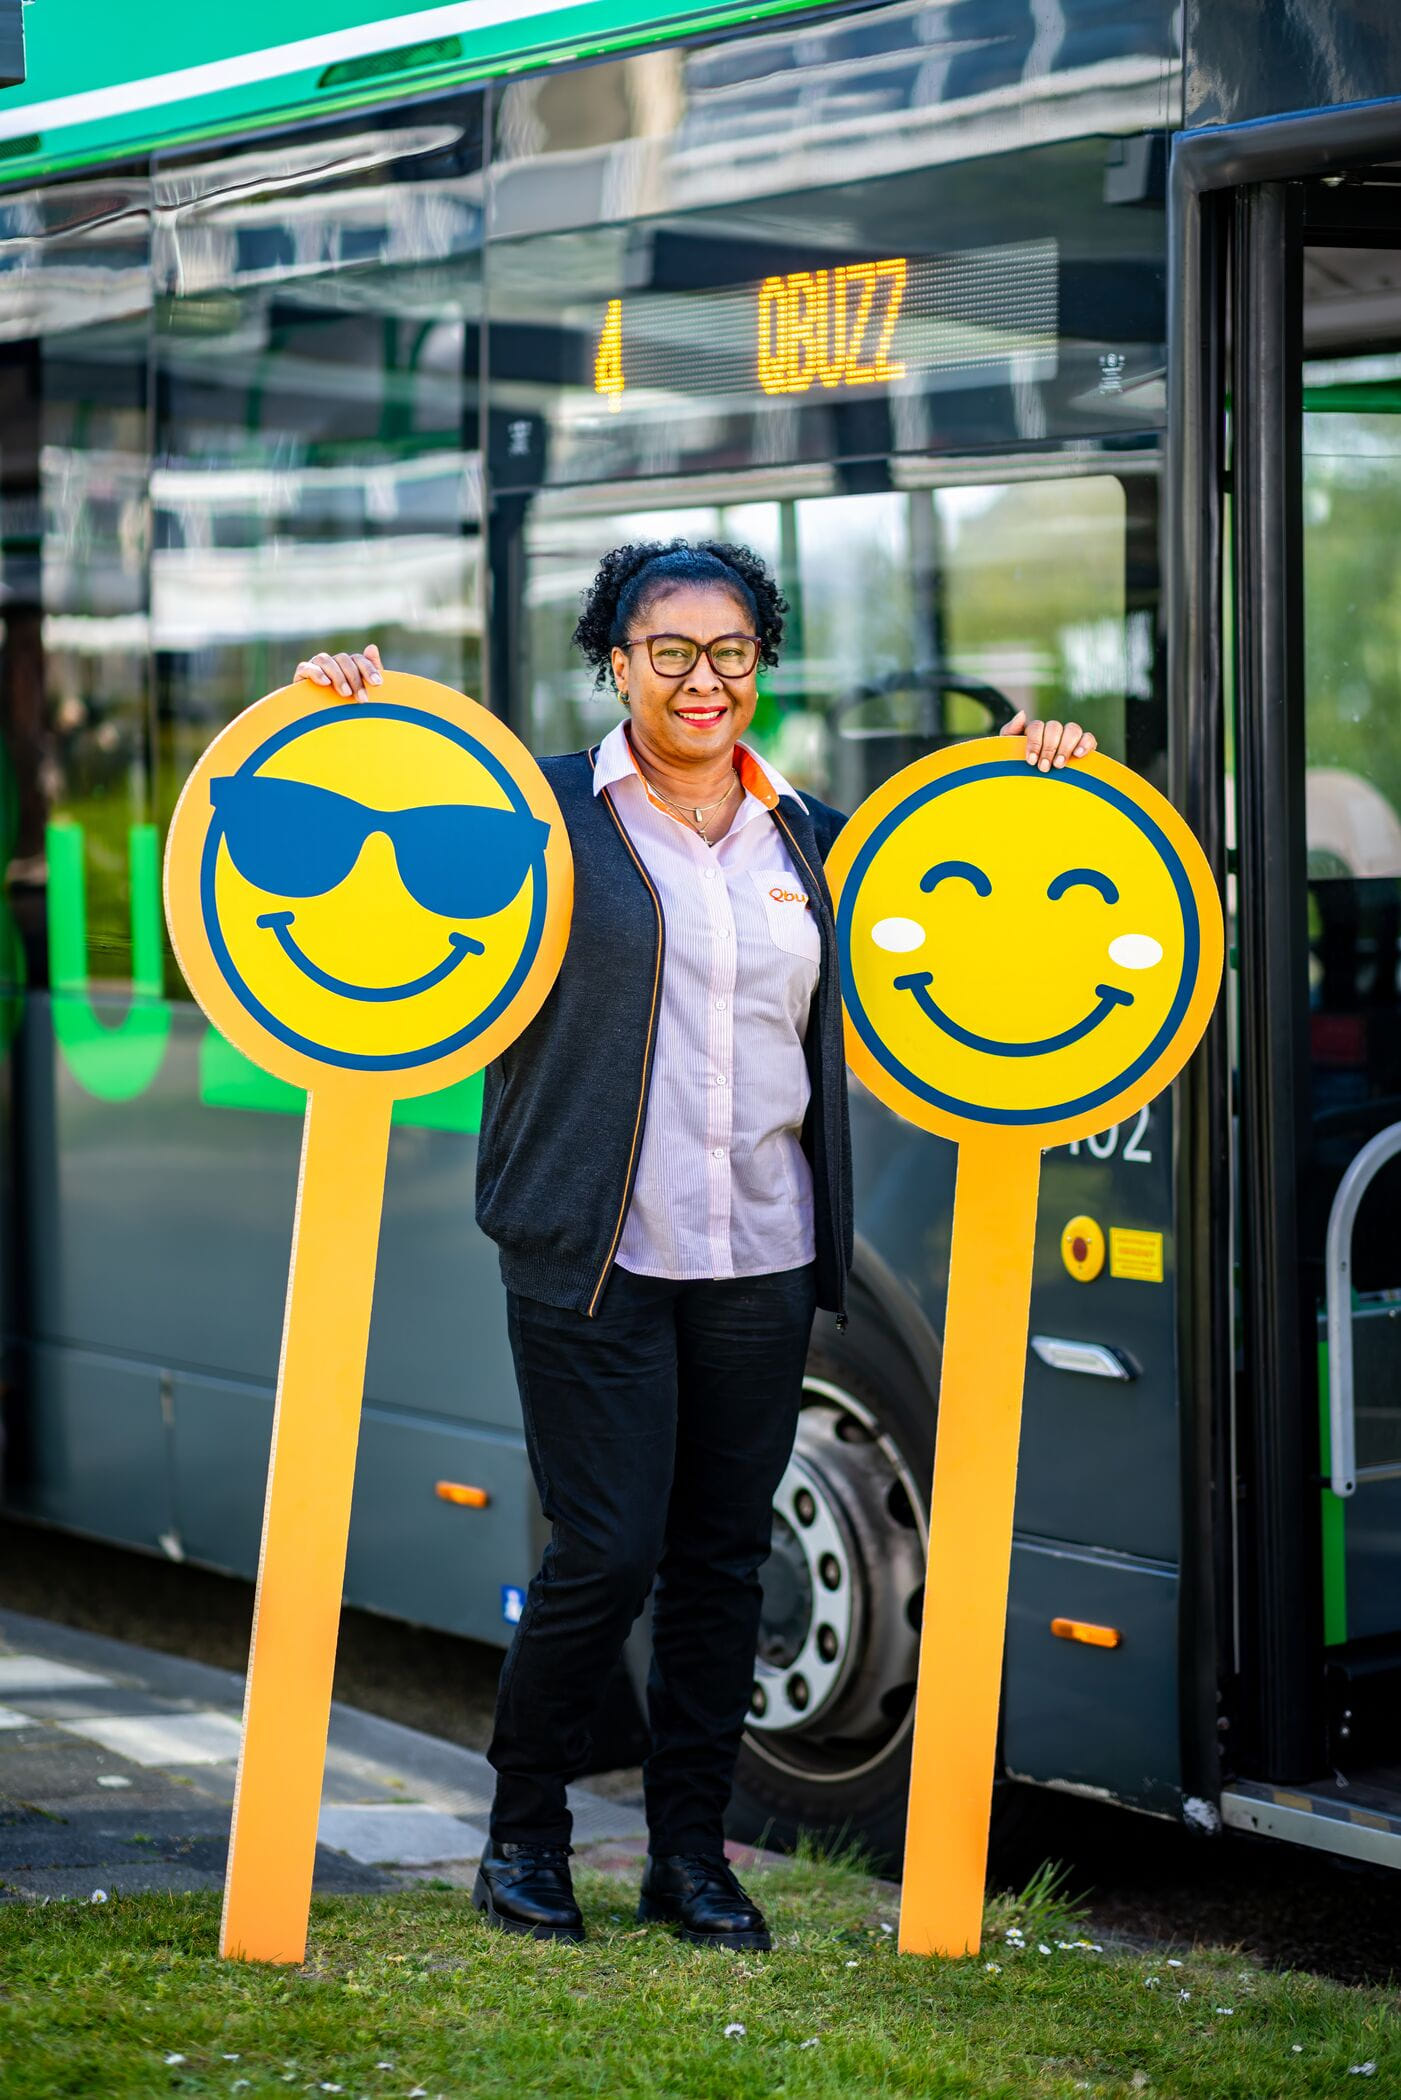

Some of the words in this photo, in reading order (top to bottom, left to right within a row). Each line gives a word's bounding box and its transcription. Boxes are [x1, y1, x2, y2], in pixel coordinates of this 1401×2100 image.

[594, 299, 625, 413] 4
[757, 258, 907, 395] QBUZZ
[1069, 1103, 1152, 1163] 02
